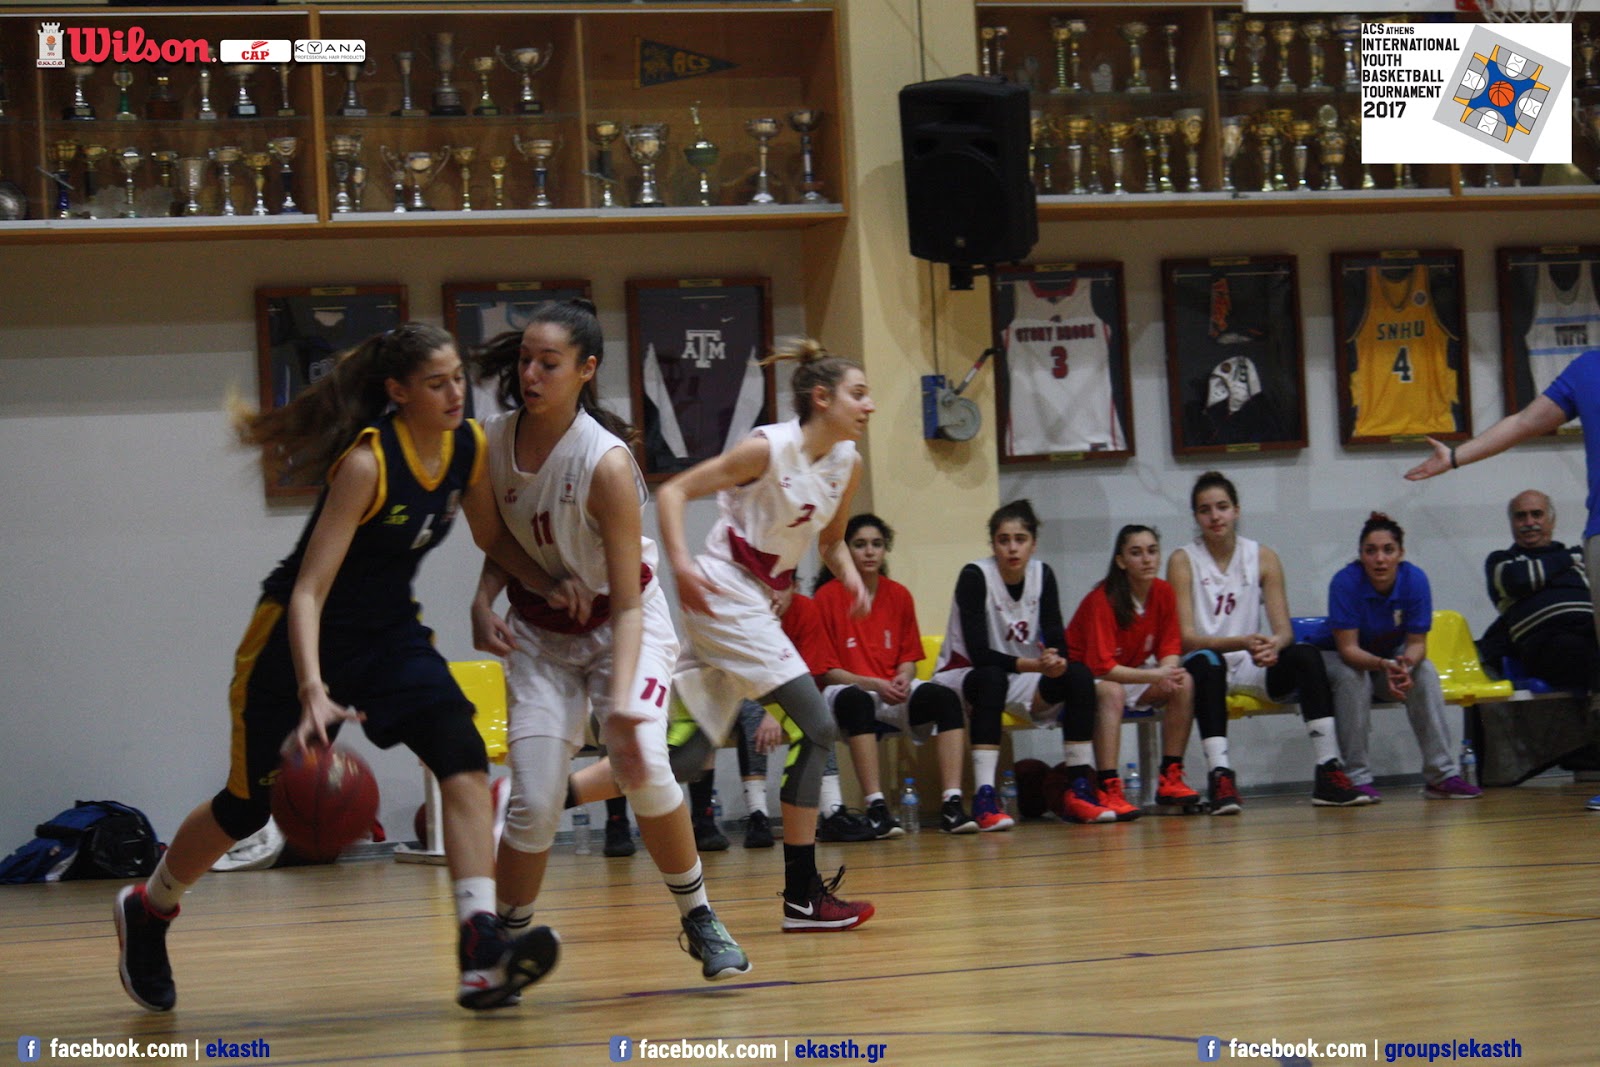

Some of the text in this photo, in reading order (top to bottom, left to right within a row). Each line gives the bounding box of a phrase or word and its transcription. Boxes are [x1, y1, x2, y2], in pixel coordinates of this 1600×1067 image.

[1376, 320, 1426, 341] SNHU
[1050, 345, 1069, 380] 3
[1392, 346, 1413, 383] 4
[409, 513, 436, 550] 6
[531, 510, 555, 547] 11
[639, 676, 667, 708] 11
